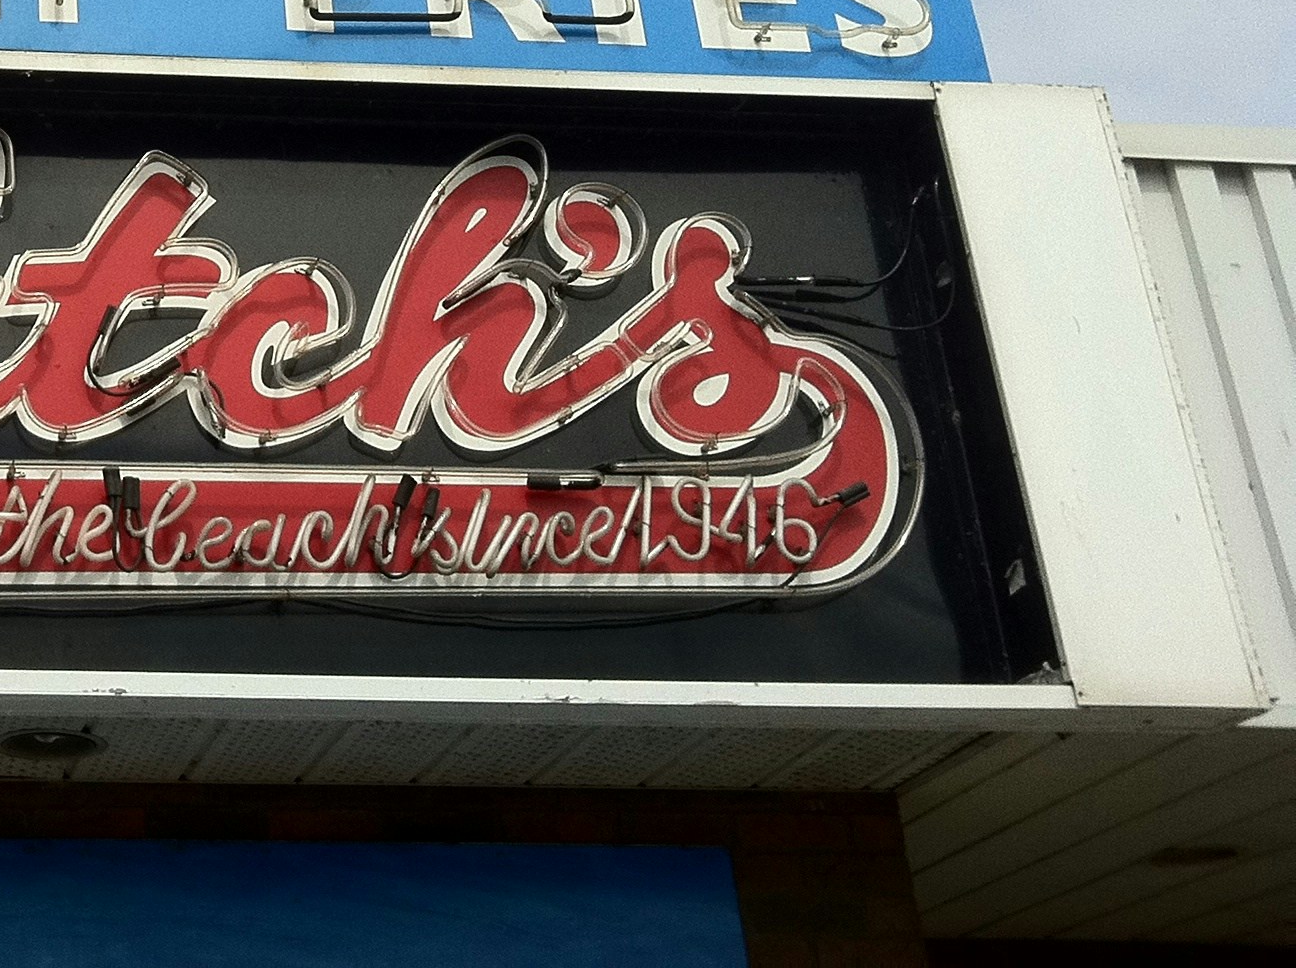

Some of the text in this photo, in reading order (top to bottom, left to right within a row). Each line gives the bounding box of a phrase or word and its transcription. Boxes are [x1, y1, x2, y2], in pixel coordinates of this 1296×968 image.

[129, 474, 395, 572] beach
[414, 487, 629, 578] since
[624, 472, 819, 567] 1946
